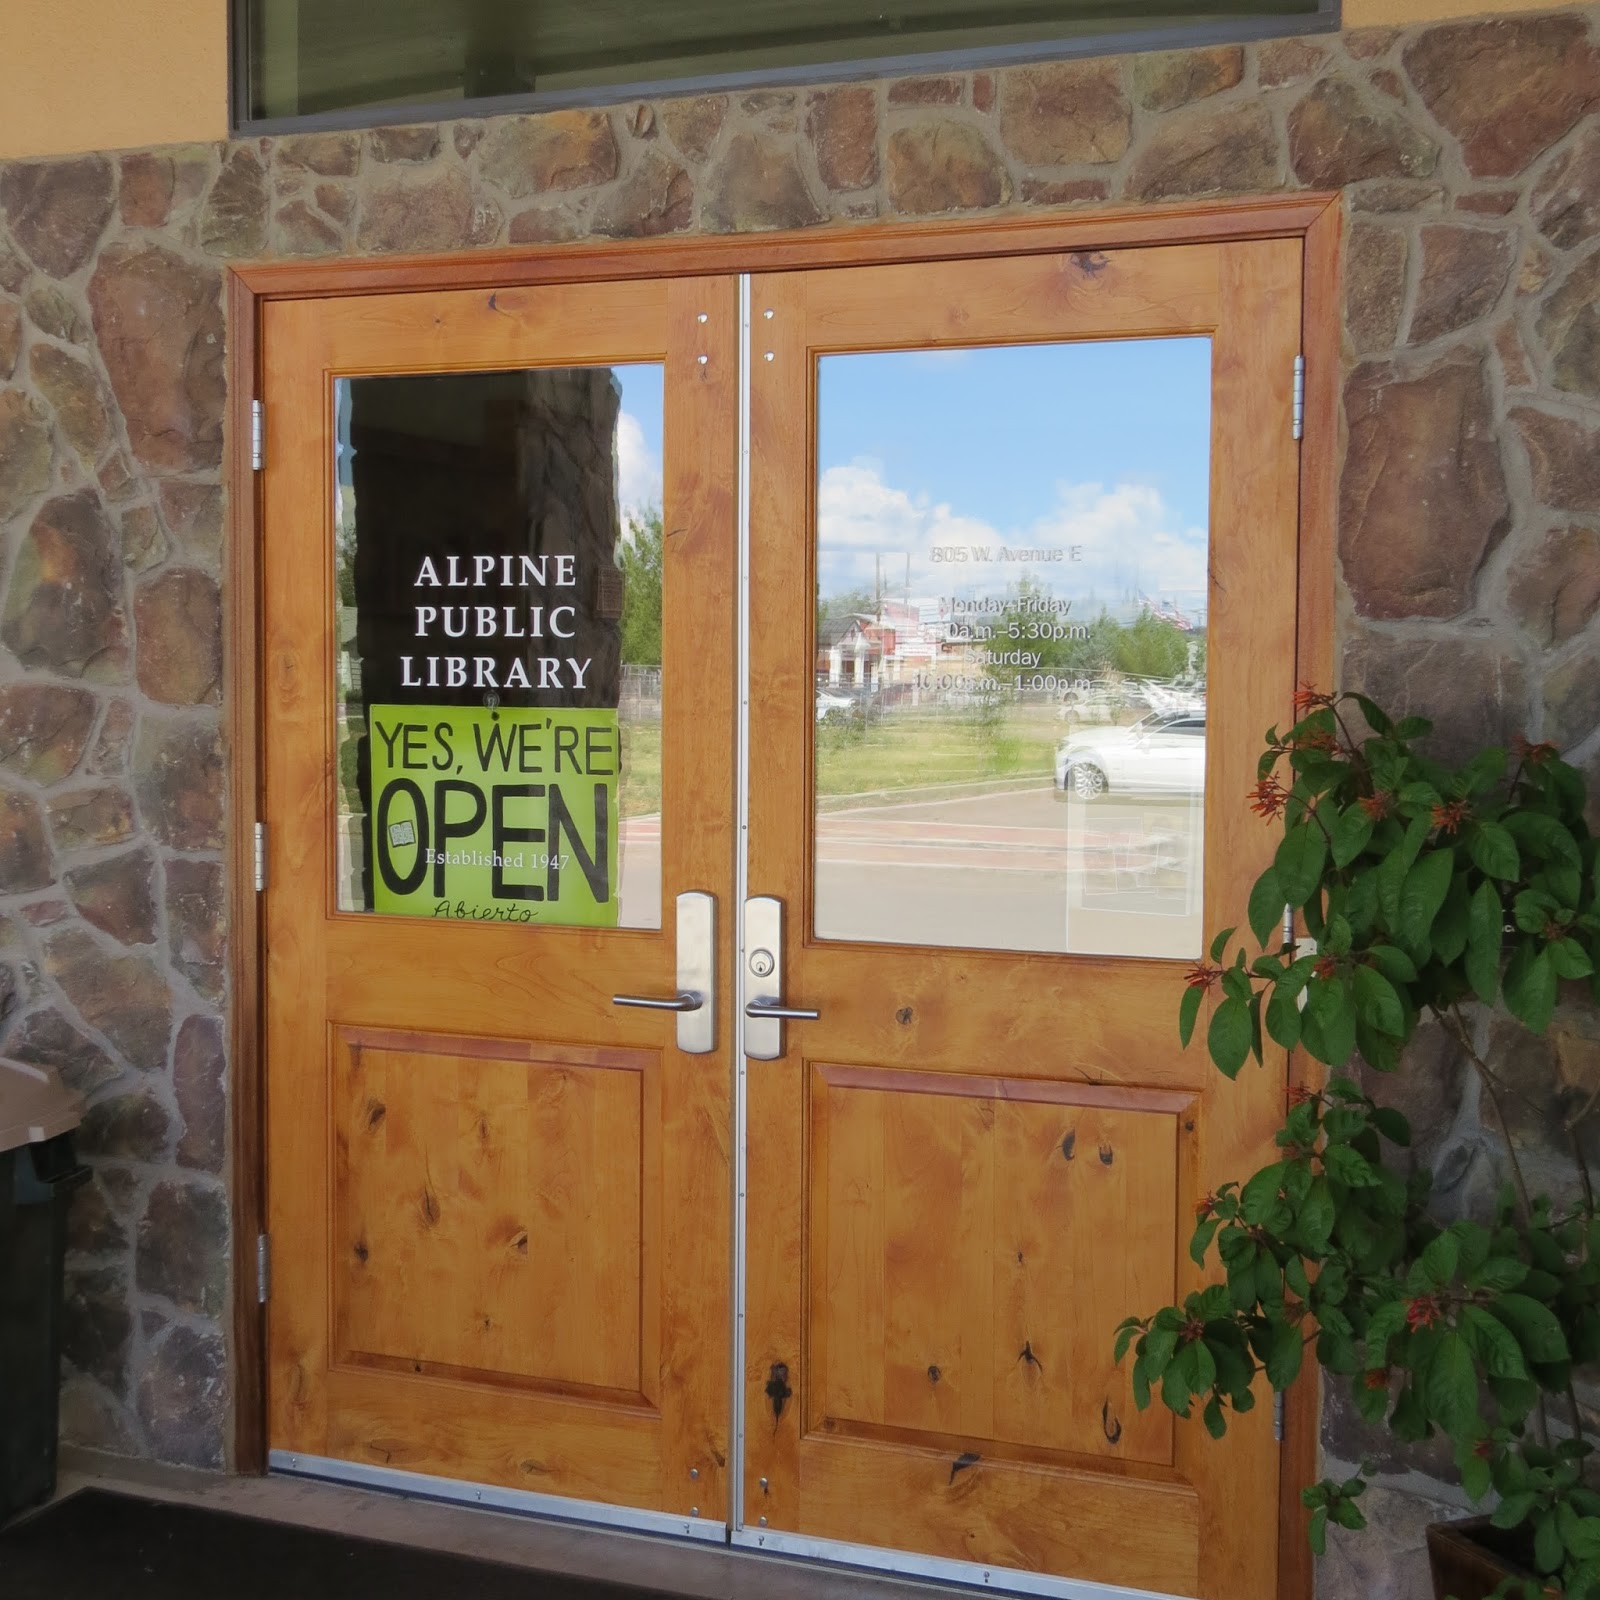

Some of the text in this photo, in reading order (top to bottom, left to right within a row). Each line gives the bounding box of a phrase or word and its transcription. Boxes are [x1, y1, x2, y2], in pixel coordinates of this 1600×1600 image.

[929, 546, 968, 563] 805
[1000, 546, 1063, 563] Avenue
[1069, 545, 1082, 562] E
[414, 555, 576, 586] ALPINE
[415, 606, 576, 638] PUBLIC
[400, 656, 592, 689] LIBRARY
[965, 648, 1042, 669] Saturday
[375, 718, 614, 775] YES, WE'RE
[377, 777, 609, 903] OPEN
[425, 848, 569, 870] Established 1947
[432, 900, 539, 923] Abierto
